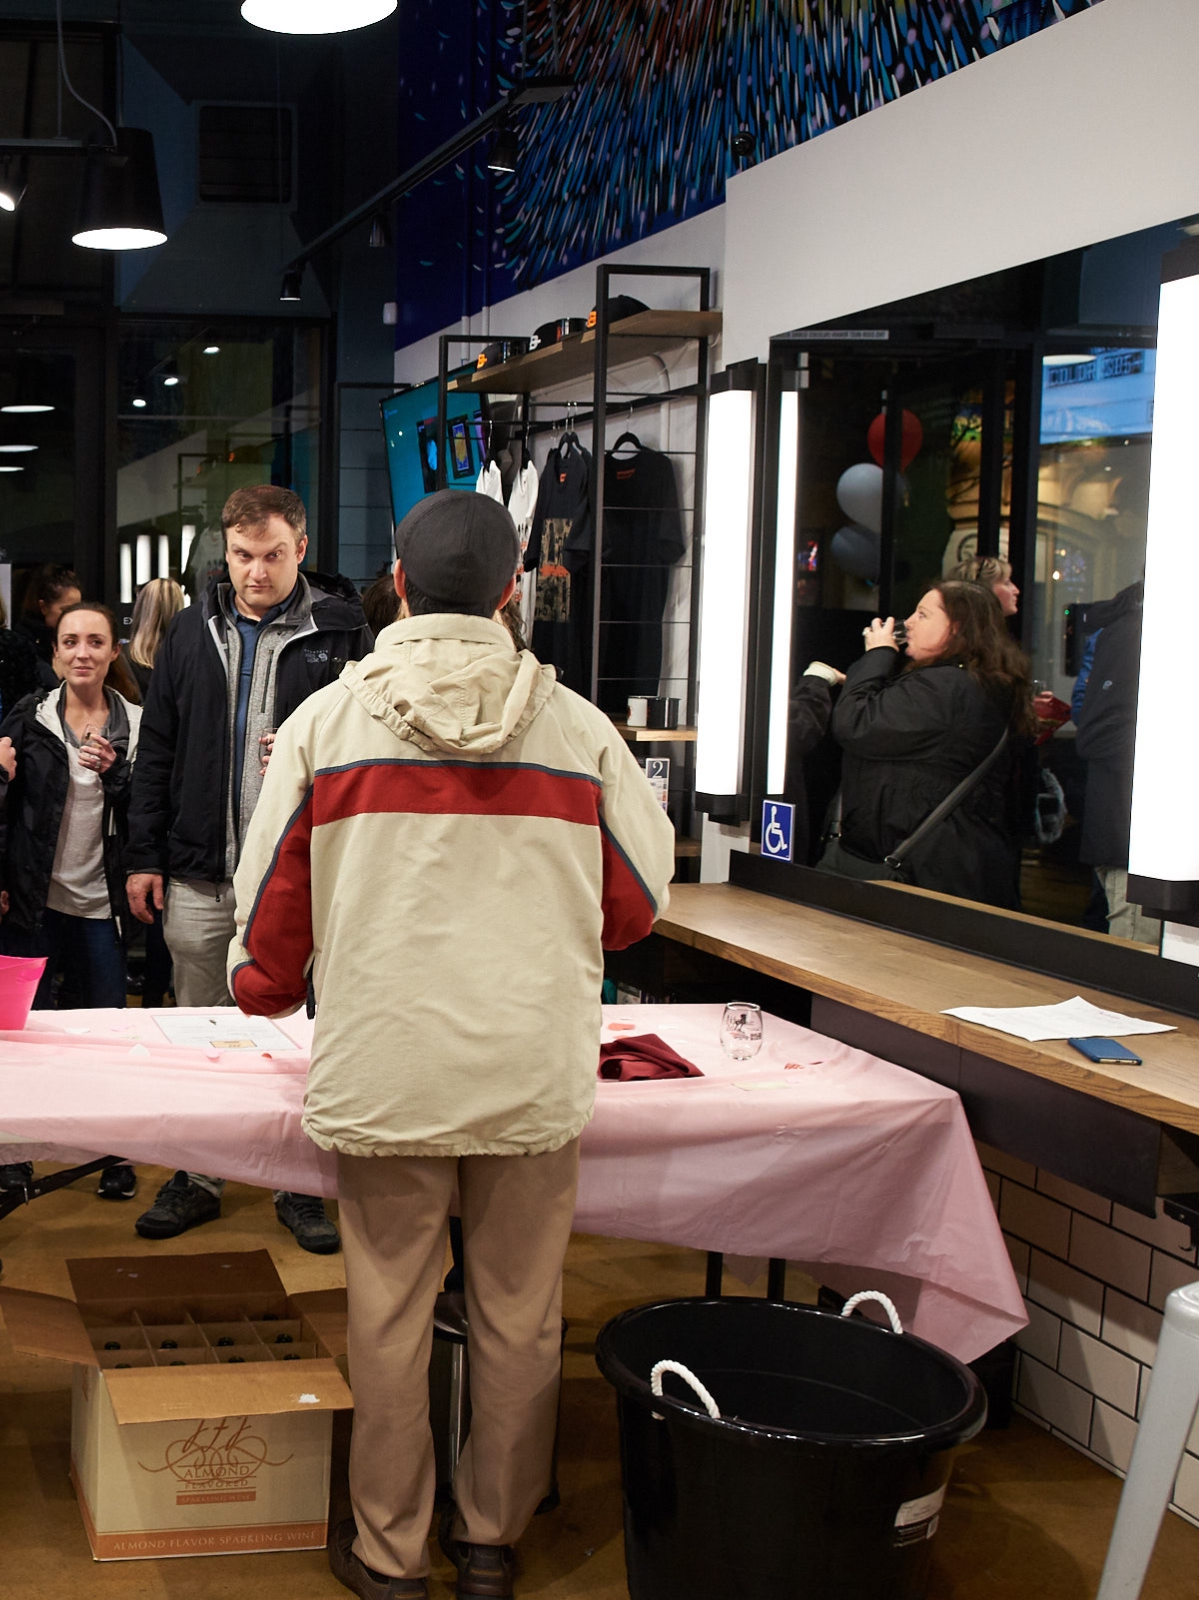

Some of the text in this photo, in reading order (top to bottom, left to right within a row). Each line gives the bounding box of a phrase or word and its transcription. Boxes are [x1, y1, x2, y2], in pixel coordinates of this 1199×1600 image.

[652, 760, 663, 779] 2
[184, 1465, 250, 1479] ALMOND
[185, 1479, 249, 1490] FLAVORED
[113, 1531, 317, 1551] ALMOND FLAVOR SPARKLING WINE
